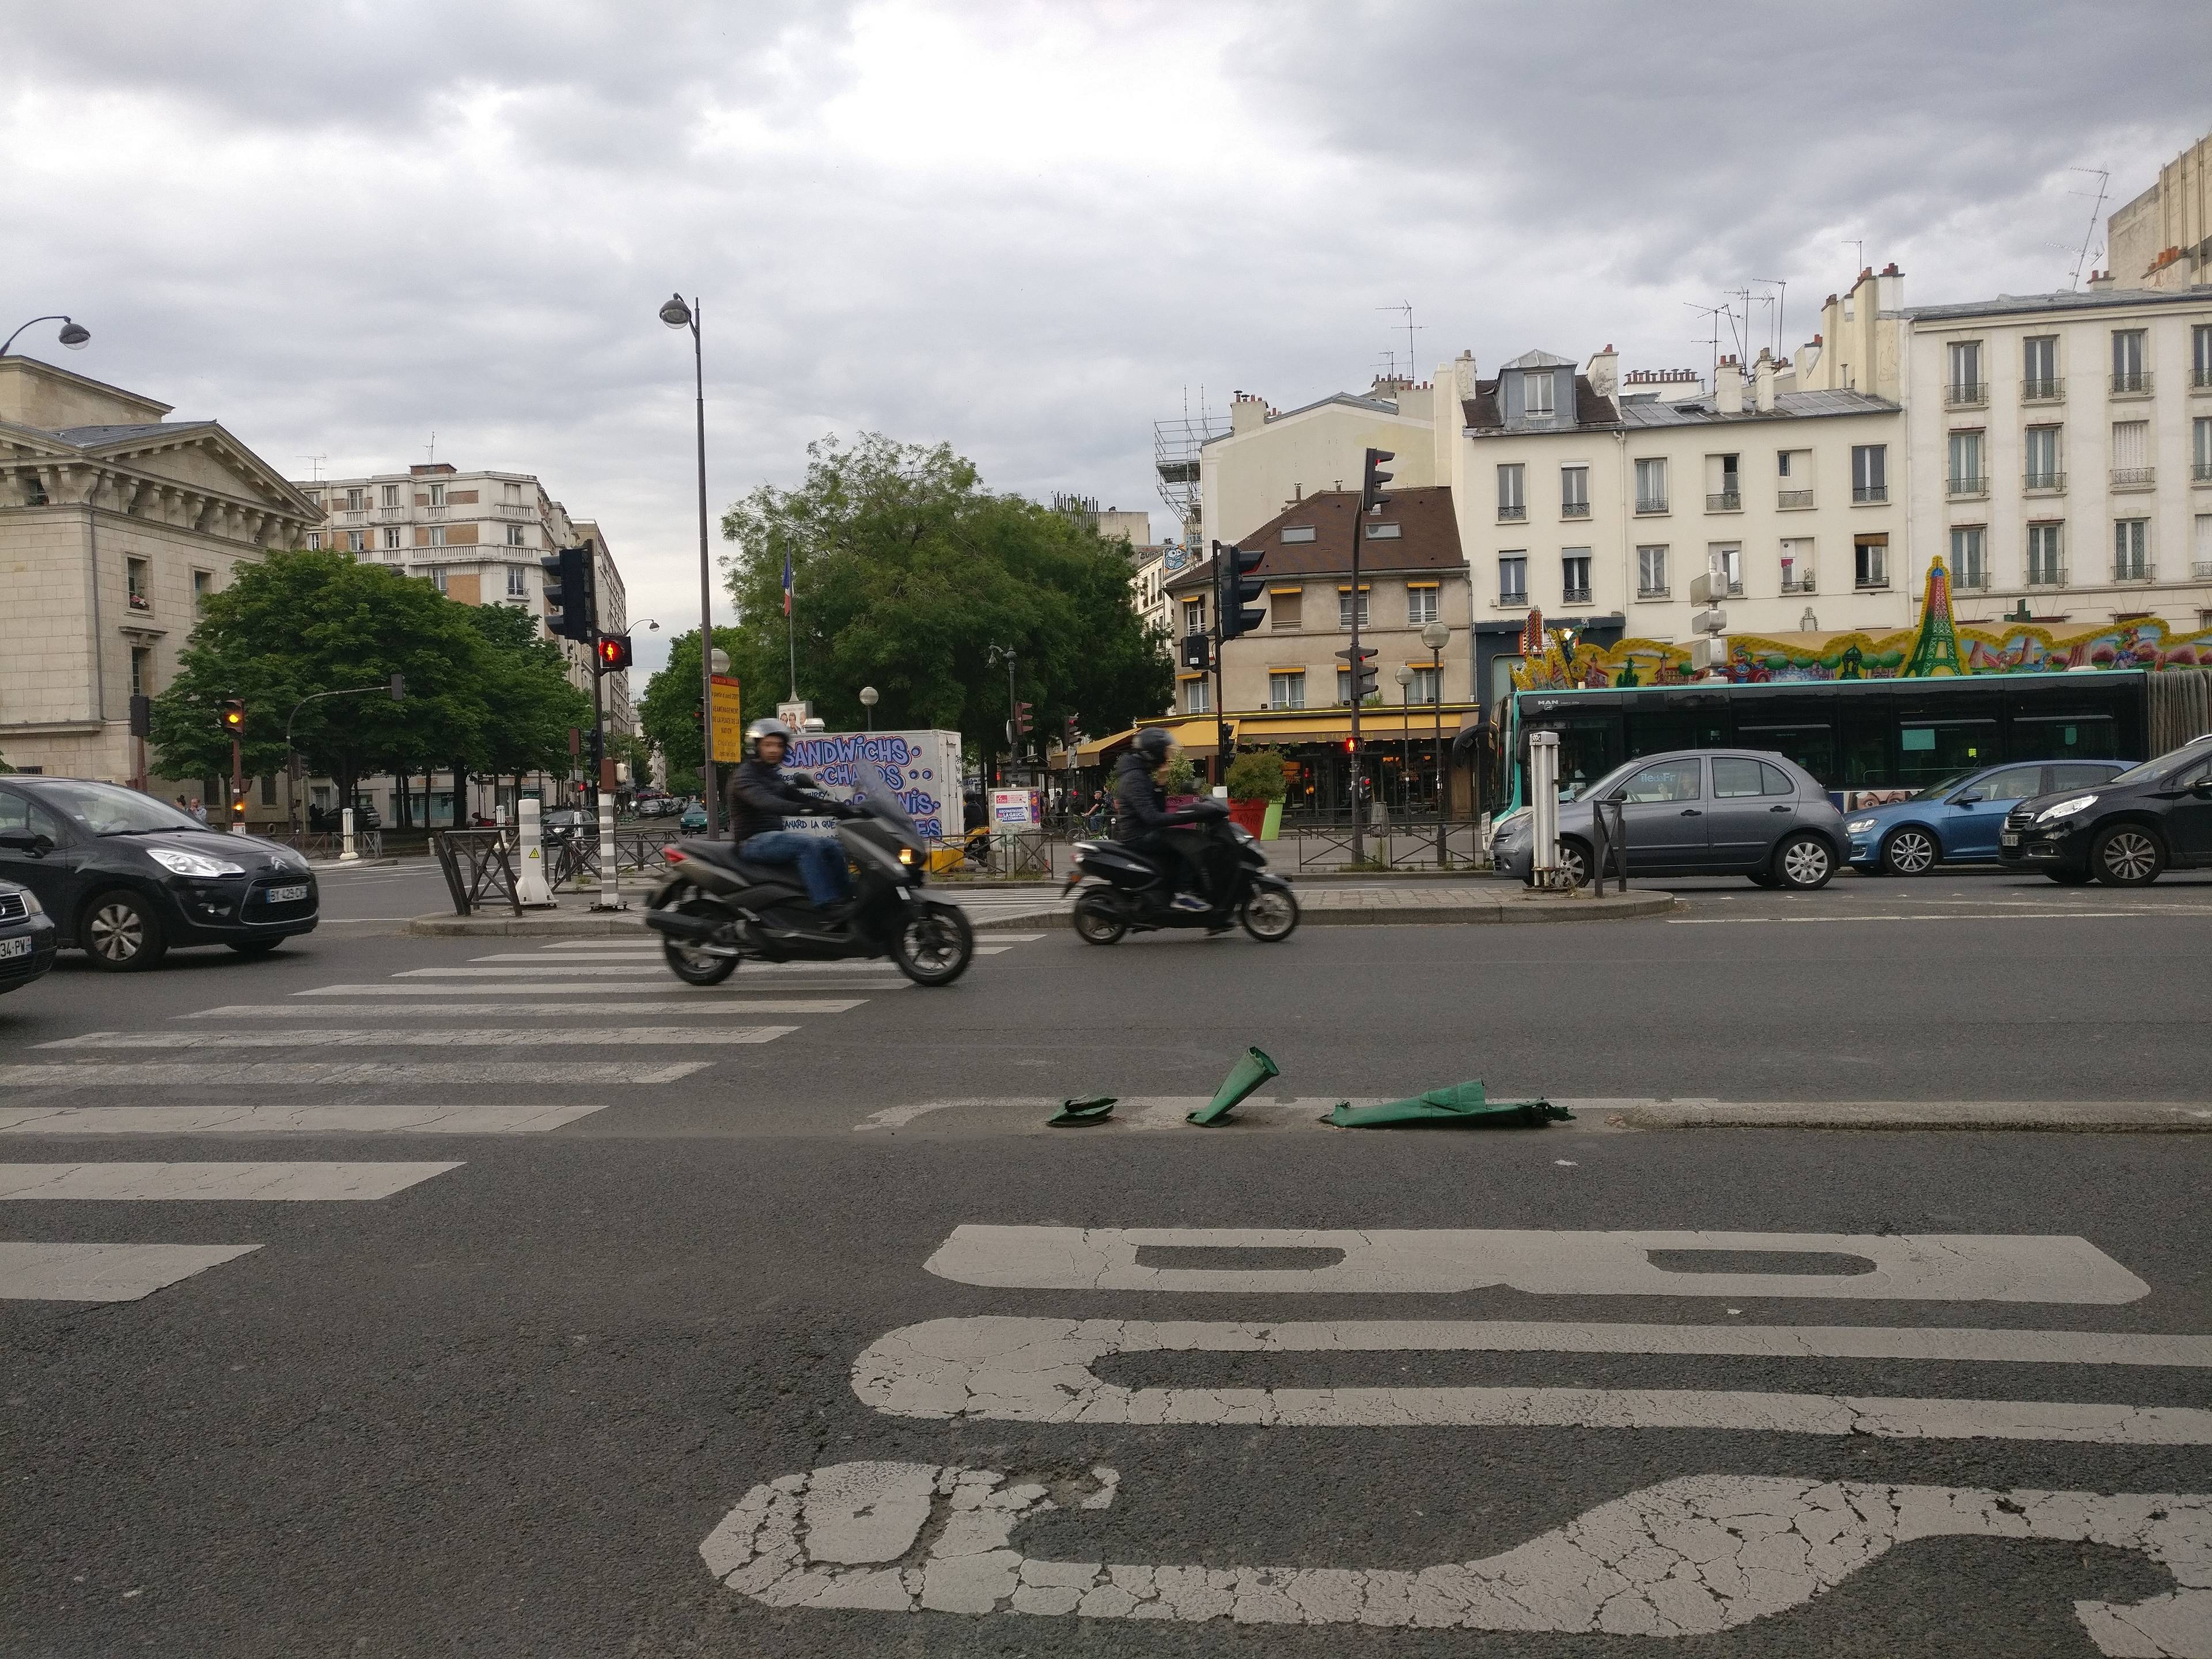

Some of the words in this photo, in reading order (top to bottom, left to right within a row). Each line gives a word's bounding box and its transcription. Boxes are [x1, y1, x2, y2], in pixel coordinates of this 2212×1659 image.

[1331, 732, 1374, 740] TERMNUS
[823, 763, 905, 791] CHADS
[783, 819, 807, 830] ANARD
